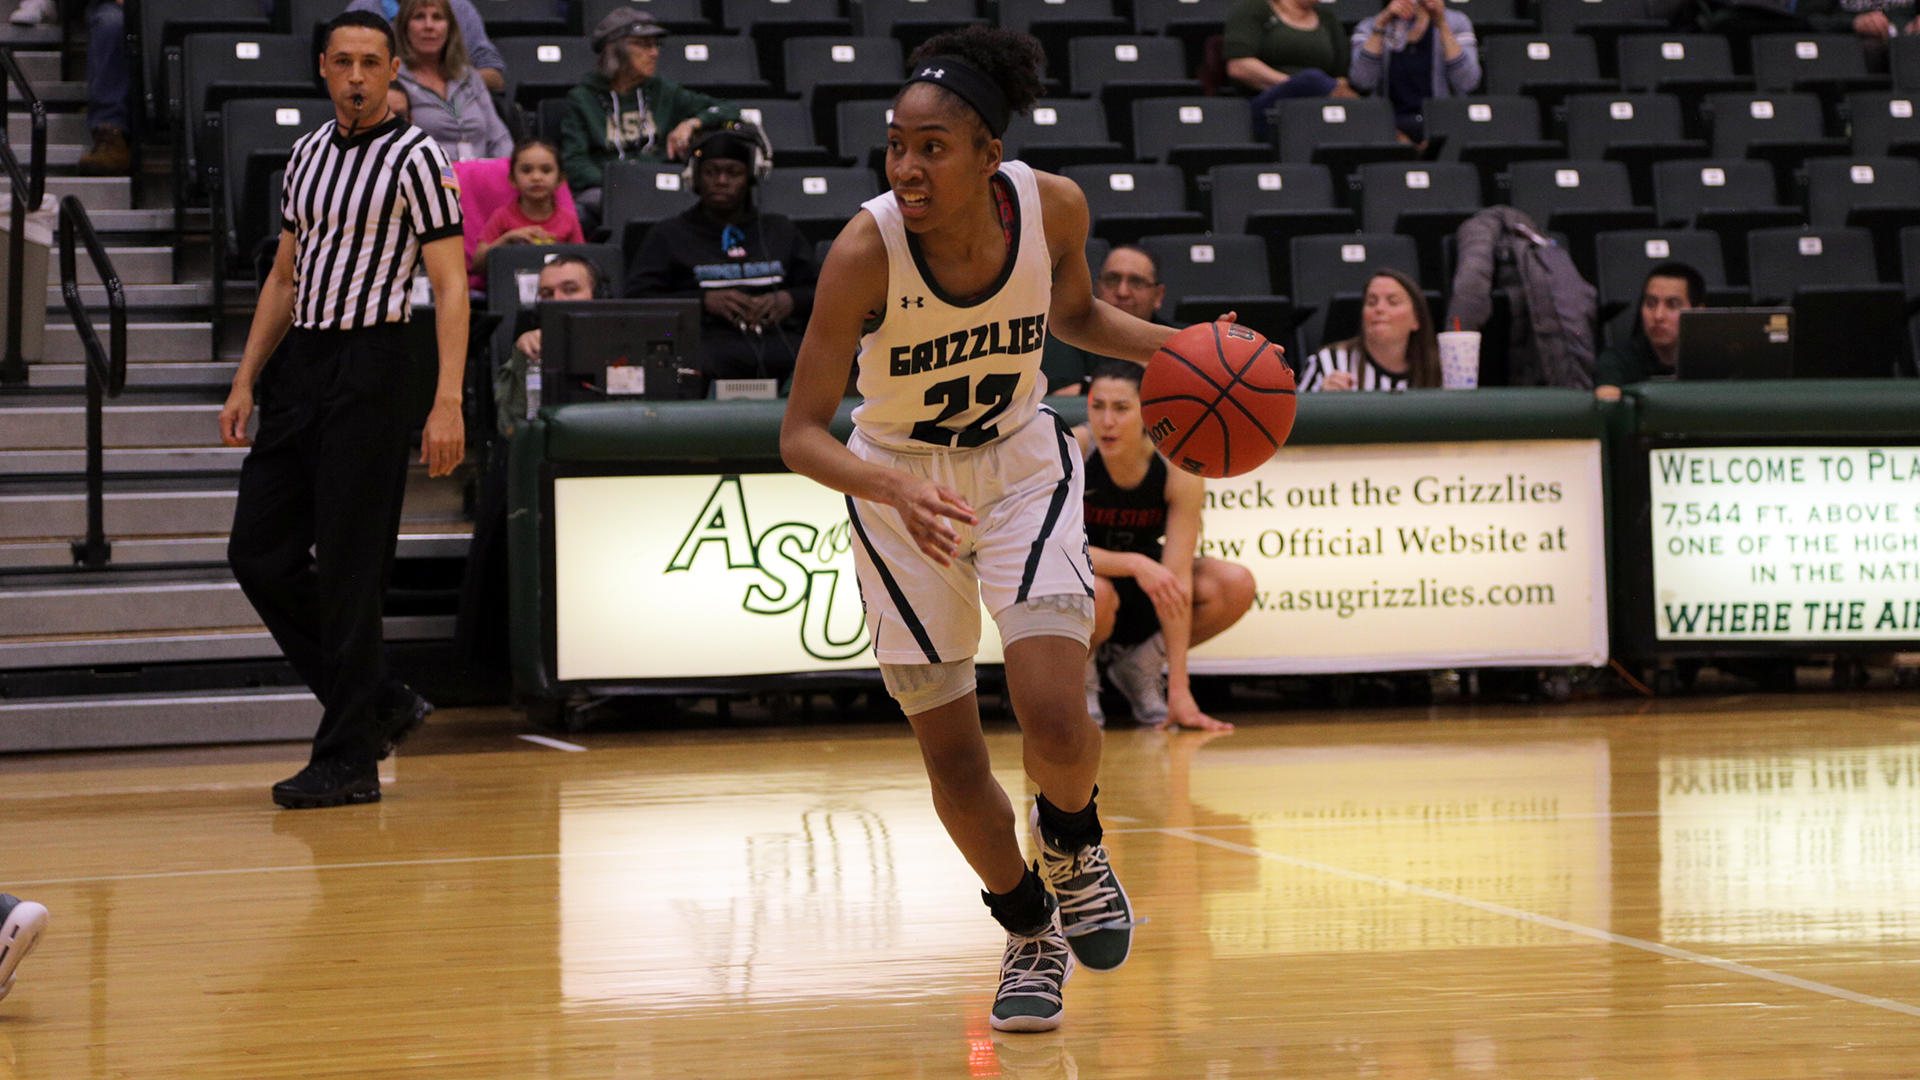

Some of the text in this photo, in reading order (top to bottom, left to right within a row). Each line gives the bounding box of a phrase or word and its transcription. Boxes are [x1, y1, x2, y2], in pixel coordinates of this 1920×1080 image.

[890, 313, 1045, 377] GRIZZLIES
[908, 372, 1022, 448] 22
[1658, 453, 1806, 484] WELCOME
[1819, 456, 1854, 482] TO
[1287, 482, 1339, 508] out
[1351, 477, 1401, 506] the
[1413, 474, 1563, 506] Grizzlies
[1661, 502, 1742, 530] 7,544
[1757, 504, 1793, 524] FT.
[1808, 503, 1900, 523] ABOVE
[1200, 525, 1568, 558] ew Official Website at
[1668, 535, 1725, 555] ONE
[1737, 534, 1772, 555] OF
[1786, 534, 1839, 553] THE
[663, 476, 871, 661] ASU
[1751, 563, 1777, 582] IN
[1791, 563, 1844, 582] THE
[1664, 602, 1793, 632] WHERE
[1804, 601, 1865, 631] THE
